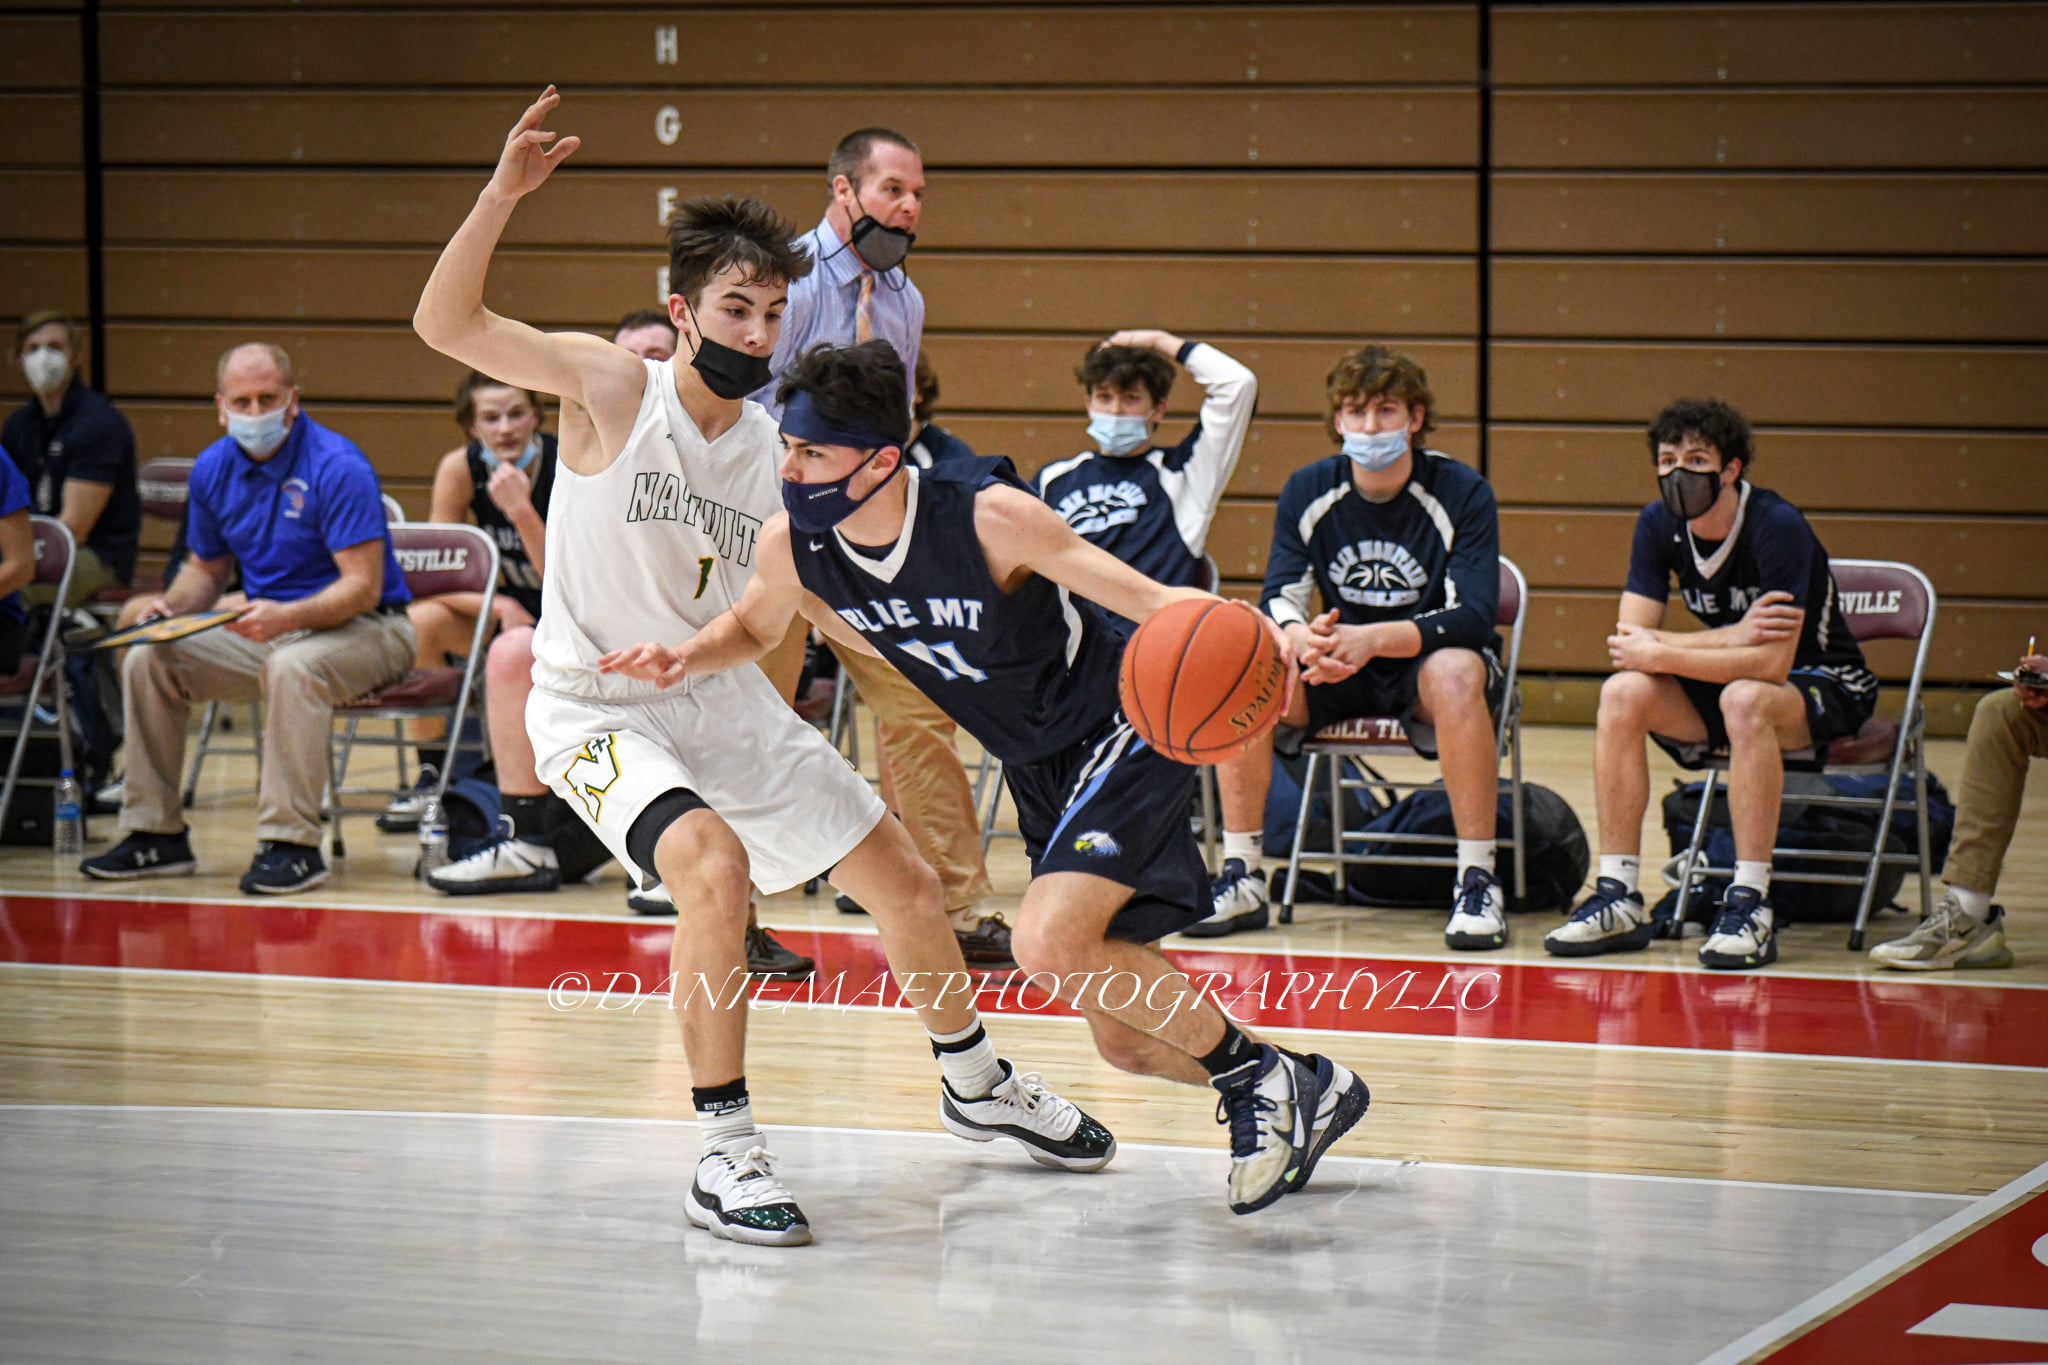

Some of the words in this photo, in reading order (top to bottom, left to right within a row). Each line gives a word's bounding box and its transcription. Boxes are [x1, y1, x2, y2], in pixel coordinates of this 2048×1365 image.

[655, 25, 678, 65] H
[655, 105, 682, 146] G
[693, 556, 715, 601] 1
[925, 598, 983, 632] MT
